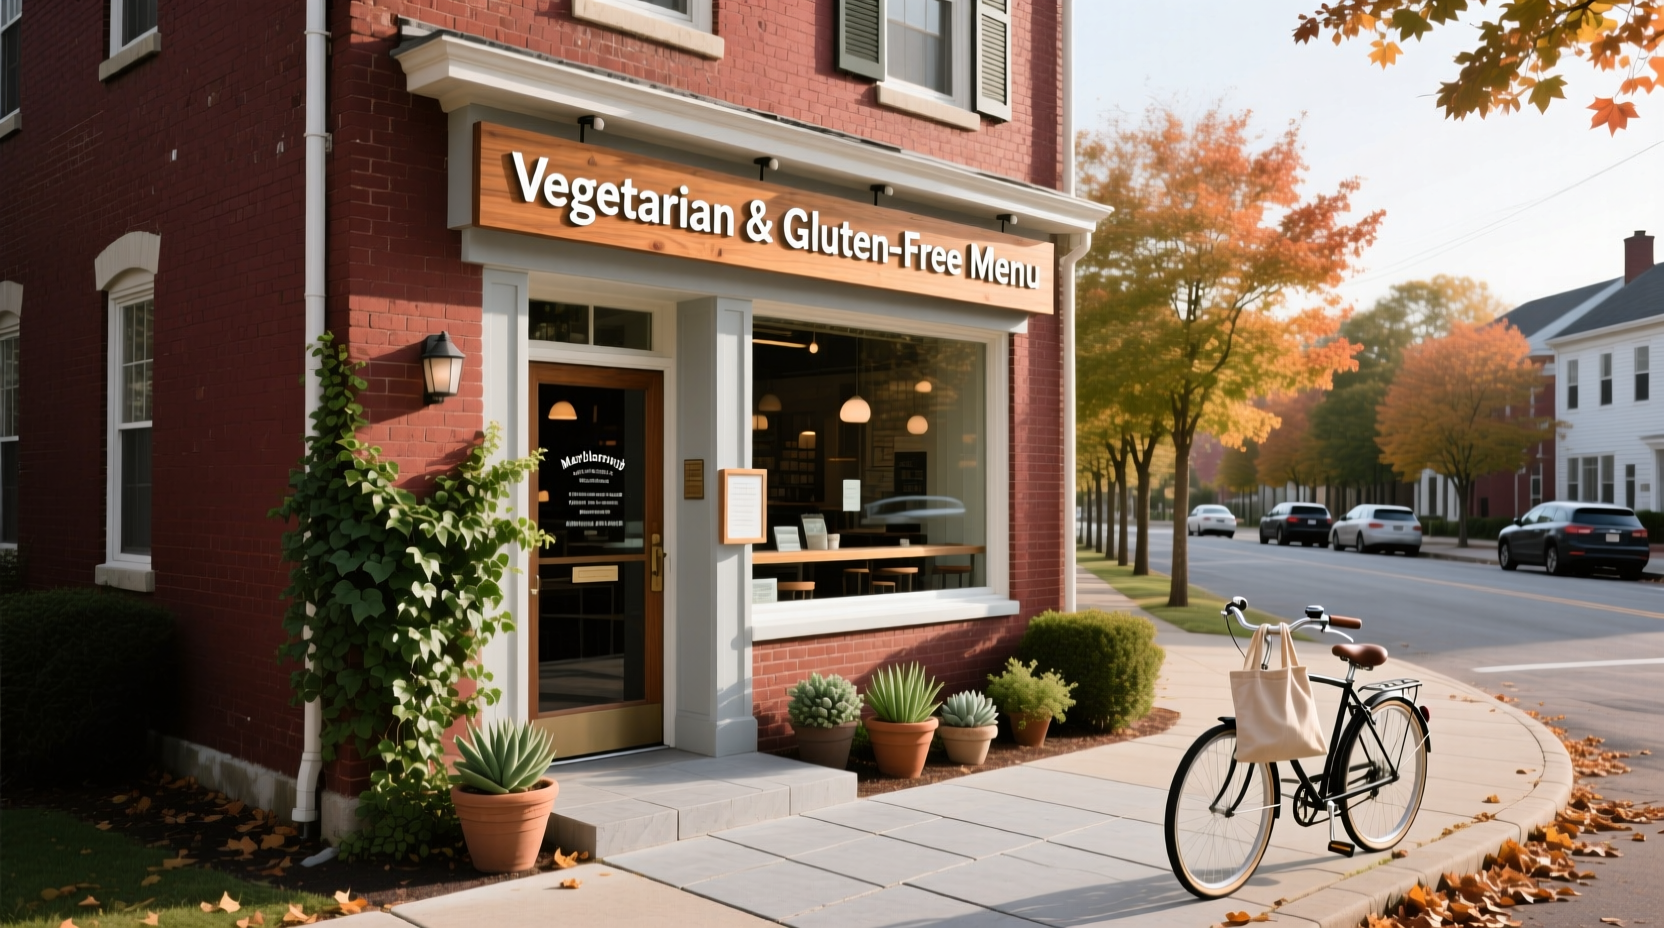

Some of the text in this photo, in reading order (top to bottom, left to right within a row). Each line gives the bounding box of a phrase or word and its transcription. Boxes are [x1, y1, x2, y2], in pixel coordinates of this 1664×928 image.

[512, 151, 1040, 290] Vegetarian & Gluten-Free Menu
